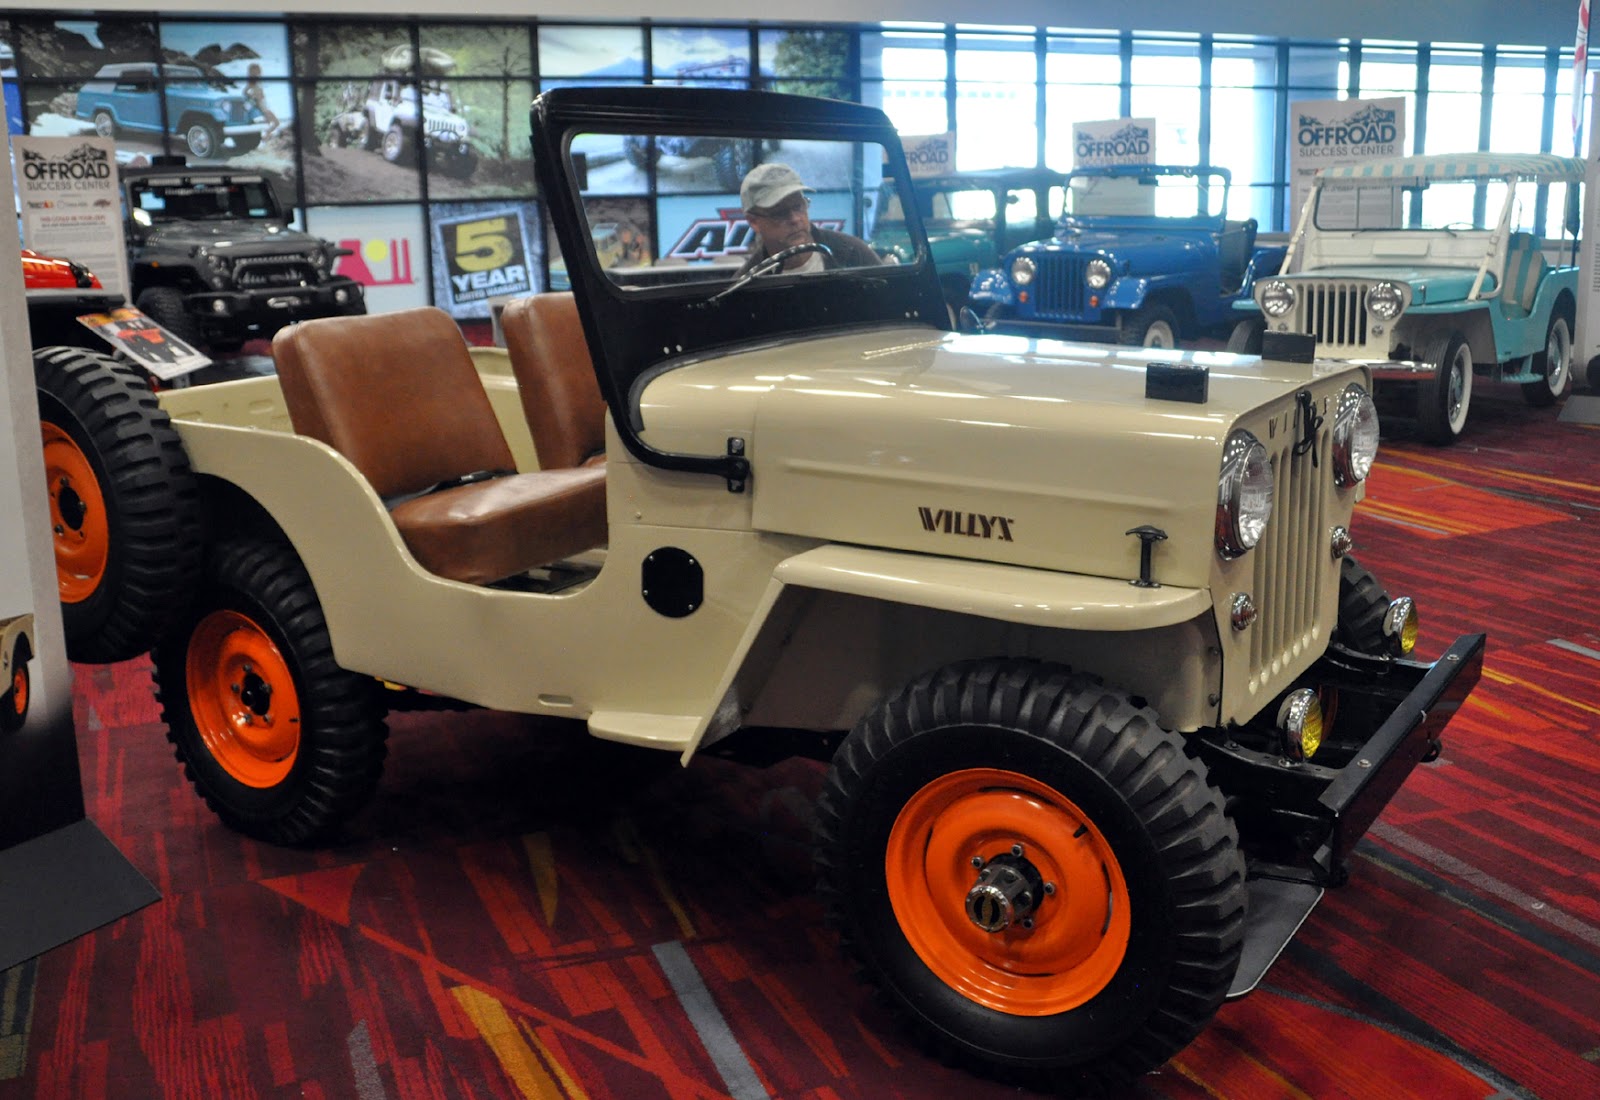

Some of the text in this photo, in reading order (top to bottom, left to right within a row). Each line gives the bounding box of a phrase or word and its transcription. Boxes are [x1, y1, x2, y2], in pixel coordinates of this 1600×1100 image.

[1299, 125, 1396, 145] OFFROAD
[1076, 141, 1150, 157] OFFROAD
[1299, 145, 1394, 157] SUCCESS CENTER
[24, 163, 110, 179] OFFROAD
[27, 181, 110, 191] SUCCESS CENTER
[455, 218, 513, 272] 5
[451, 264, 525, 292] YEAR
[455, 282, 527, 302] LIMITED WARRANTY
